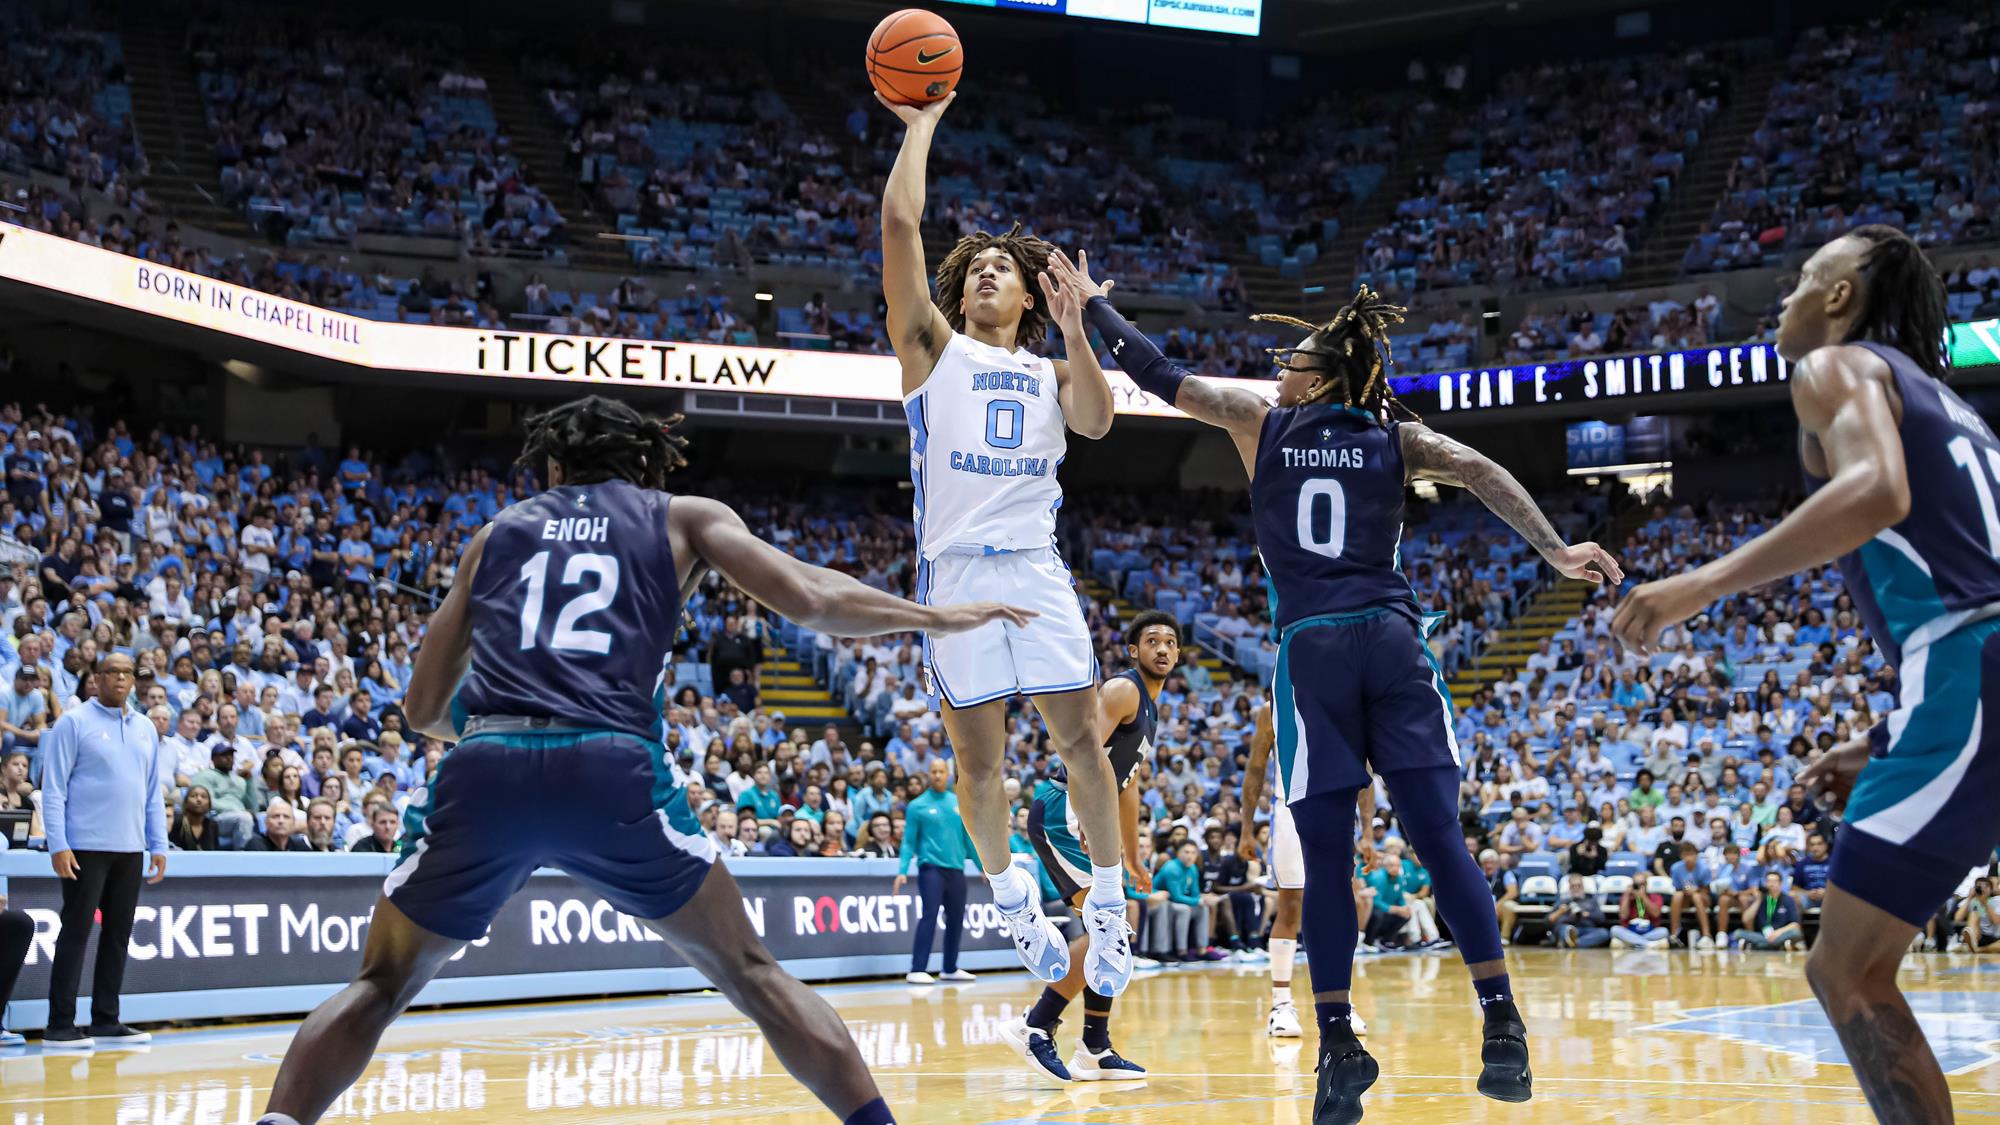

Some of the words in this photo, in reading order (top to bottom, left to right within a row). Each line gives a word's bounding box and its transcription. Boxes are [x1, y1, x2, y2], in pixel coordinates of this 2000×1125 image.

[138, 267, 201, 303] BORN
[211, 287, 232, 311] IN
[241, 296, 313, 334] CHAPEL
[322, 317, 360, 344] HILL
[478, 335, 776, 385] iTICKET.LAW
[972, 371, 1040, 397] NORTH
[1439, 369, 1514, 411] DEAN
[1535, 366, 1563, 402] E.
[1583, 353, 1685, 399] SMITH
[1707, 344, 1788, 388] CENT
[985, 399, 1024, 449] 0
[950, 450, 1048, 477] CAROLINA
[1282, 447, 1364, 468] THOMAS
[1568, 447, 1621, 463] AFE
[542, 517, 609, 542] ENOH
[1297, 478, 1345, 559] 0
[520, 551, 619, 654] 12
[23, 903, 268, 965] RCKET
[793, 895, 911, 935] ROCKET
